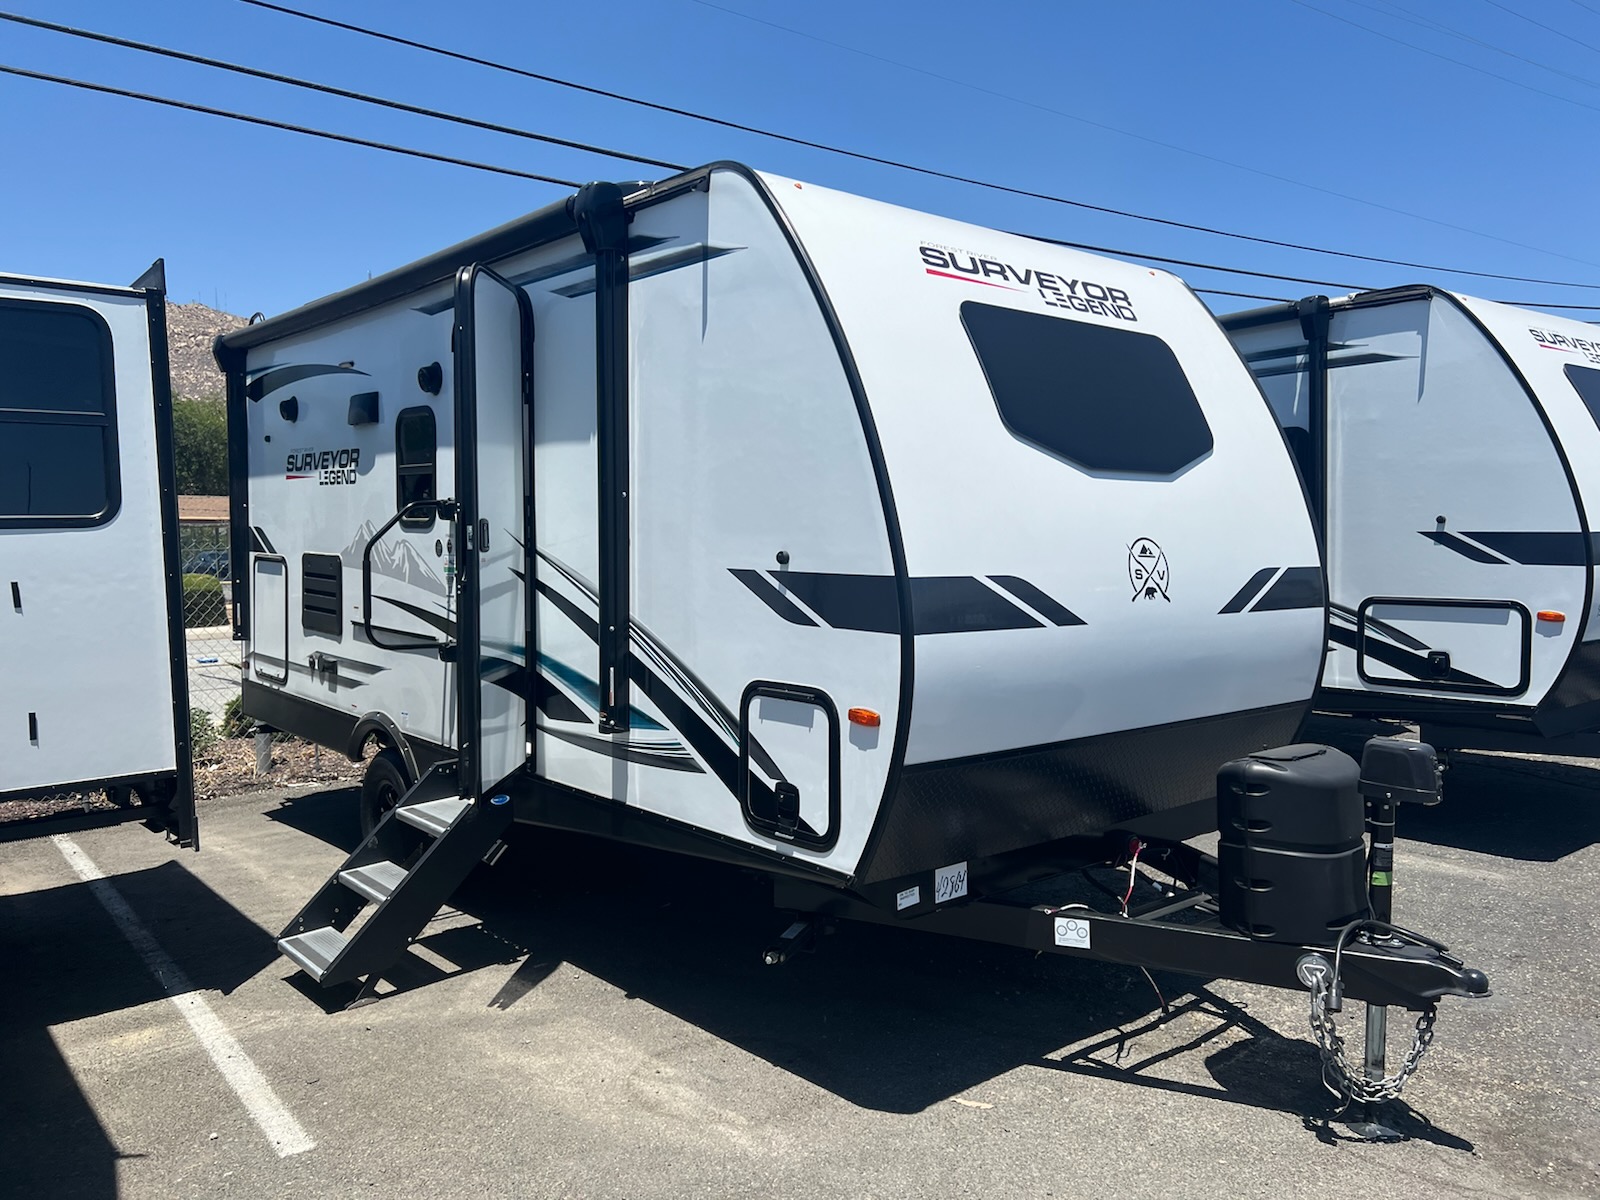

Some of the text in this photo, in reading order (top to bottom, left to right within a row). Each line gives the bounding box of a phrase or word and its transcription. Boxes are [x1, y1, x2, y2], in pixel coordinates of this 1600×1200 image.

[920, 240, 964, 254] FOREST
[919, 246, 1133, 307] SURVEYOR
[1037, 288, 1138, 322] LEGEND
[286, 448, 360, 472] SURVEYOR
[319, 469, 357, 486] LEGEND
[1134, 569, 1165, 580] S V
